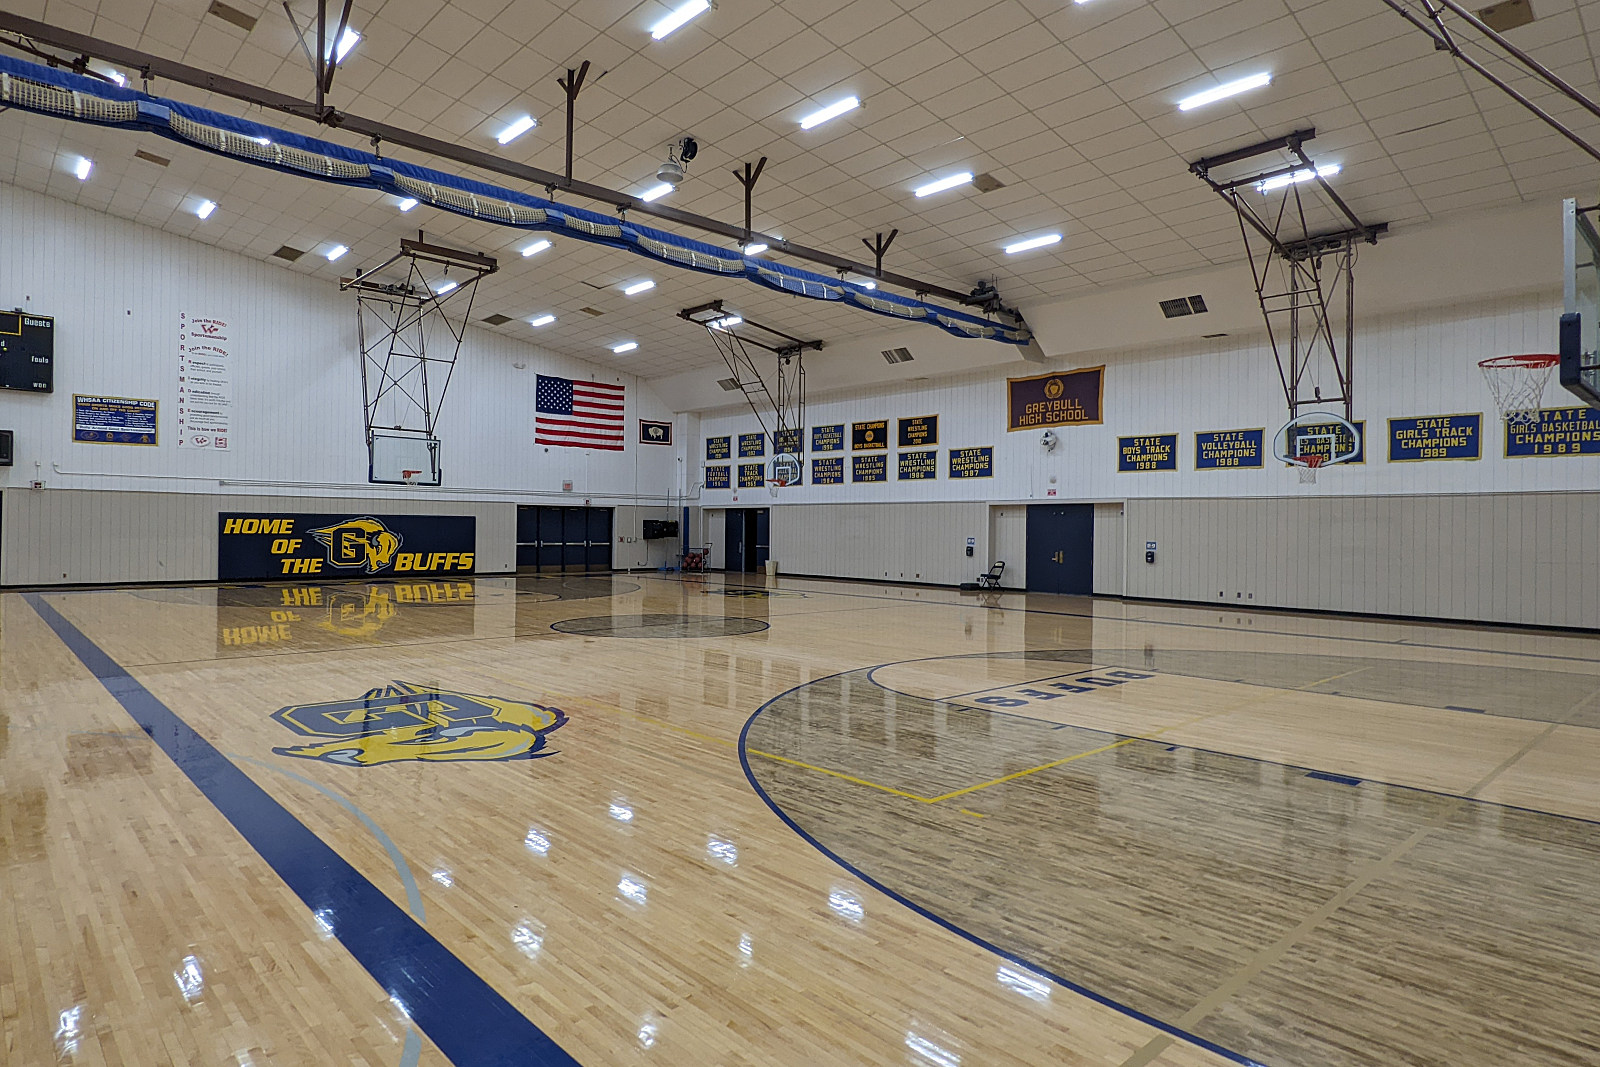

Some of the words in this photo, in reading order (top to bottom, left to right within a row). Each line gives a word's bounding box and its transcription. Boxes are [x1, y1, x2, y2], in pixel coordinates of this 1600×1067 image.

[24, 317, 51, 328] Guests
[1026, 399, 1082, 414] GREYBULL
[1019, 414, 1042, 425] HIGH
[1046, 409, 1088, 422] SCHOOL
[1537, 409, 1586, 421] TATE
[1416, 418, 1451, 428] STATE
[1510, 424, 1536, 434] GIRLS
[1542, 420, 1600, 432] BASKETBAL
[1307, 426, 1341, 435] STATE
[1396, 429, 1428, 439] GIRLS
[1435, 427, 1473, 437] TRACK
[1134, 438, 1160, 446] STATE
[1214, 432, 1244, 441] STATE
[1516, 431, 1600, 444] CHAMPIONS
[1202, 440, 1257, 450] VOLLEYBALL
[1402, 437, 1466, 448] CHAMPIONS
[1146, 445, 1171, 453] TRACK
[1203, 449, 1256, 459] CHAMPIONS
[1420, 448, 1447, 457] 1989
[1534, 443, 1580, 454] 1989
[952, 456, 989, 464] WRESTLING
[1126, 453, 1168, 462] CHAMPIONS
[952, 462, 989, 471] CHAMPIONS
[224, 519, 294, 534] HOME
[271, 539, 302, 554] OF
[281, 558, 323, 574] THE
[394, 553, 474, 571] BUFFS
[974, 670, 1156, 707] BUFFS
